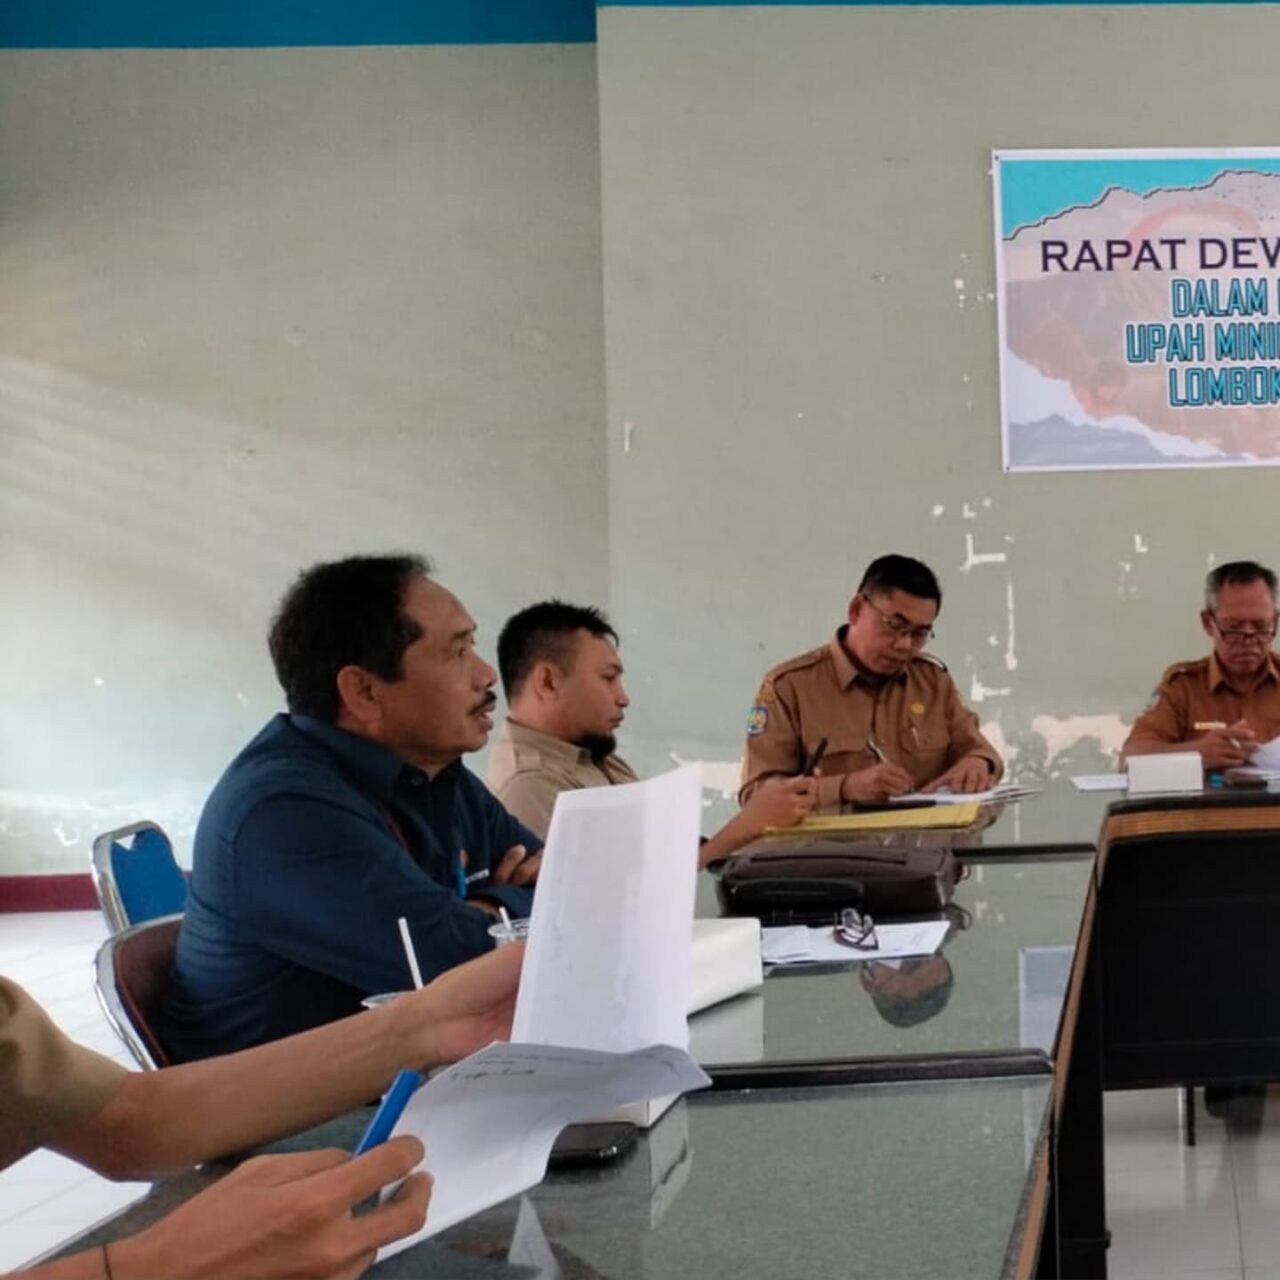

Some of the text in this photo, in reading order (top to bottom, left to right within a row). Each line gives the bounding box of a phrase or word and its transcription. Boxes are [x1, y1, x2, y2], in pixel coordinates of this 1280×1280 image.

[1041, 238, 1187, 272] RAPAT
[1171, 277, 1269, 318] DALAM
[1126, 323, 1206, 364] UPAH
